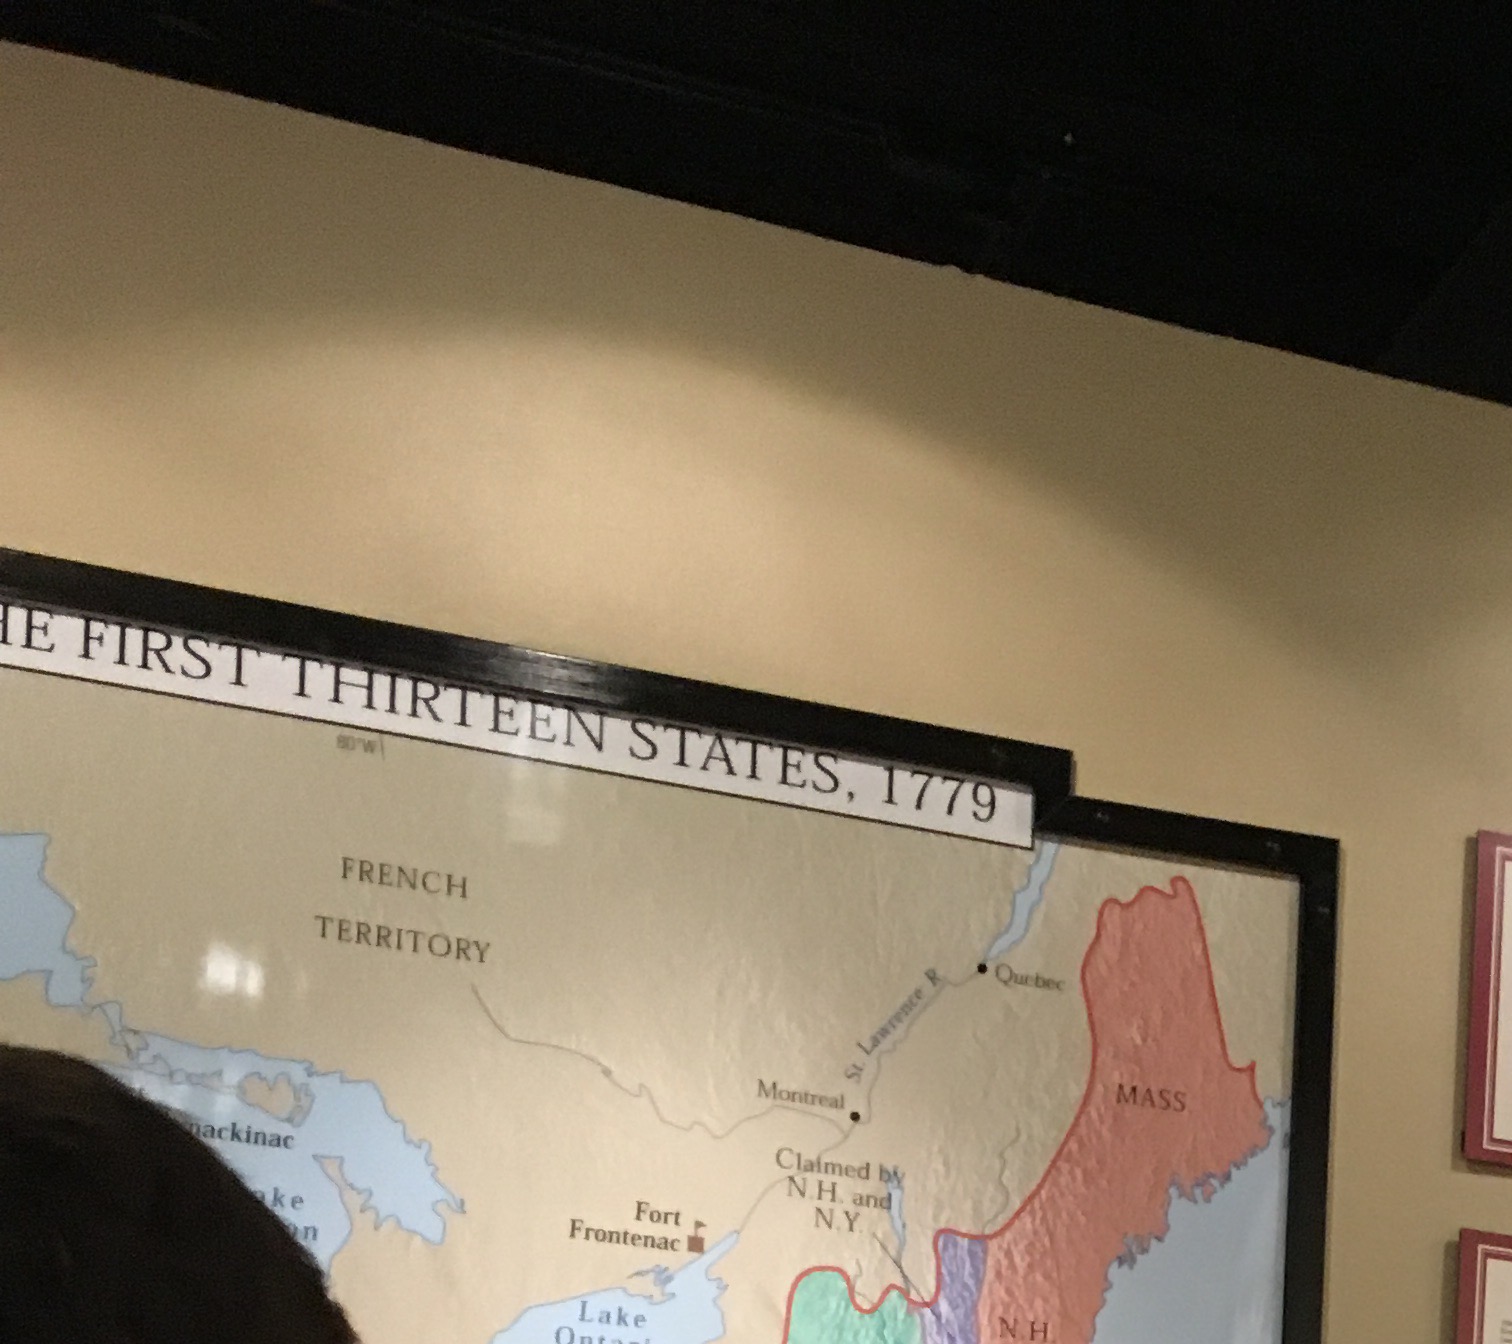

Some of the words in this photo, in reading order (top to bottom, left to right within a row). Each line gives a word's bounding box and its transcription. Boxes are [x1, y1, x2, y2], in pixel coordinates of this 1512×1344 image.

[78, 614, 261, 687] FIRST
[281, 653, 609, 752] THIRTEEN
[628, 718, 855, 802] STATES,
[882, 764, 997, 823] 1779
[341, 856, 469, 899] FRENCH
[314, 914, 492, 965] TERRITORY
[994, 963, 1066, 992] Quebec
[856, 987, 925, 1056] Lawrence
[757, 1078, 845, 1110] Montreal
[775, 1147, 870, 1181] Claimed
[635, 1200, 681, 1227] Fort
[852, 1190, 893, 1212] and
[569, 1218, 681, 1252] Frontenac
[579, 1300, 648, 1328] Lake
